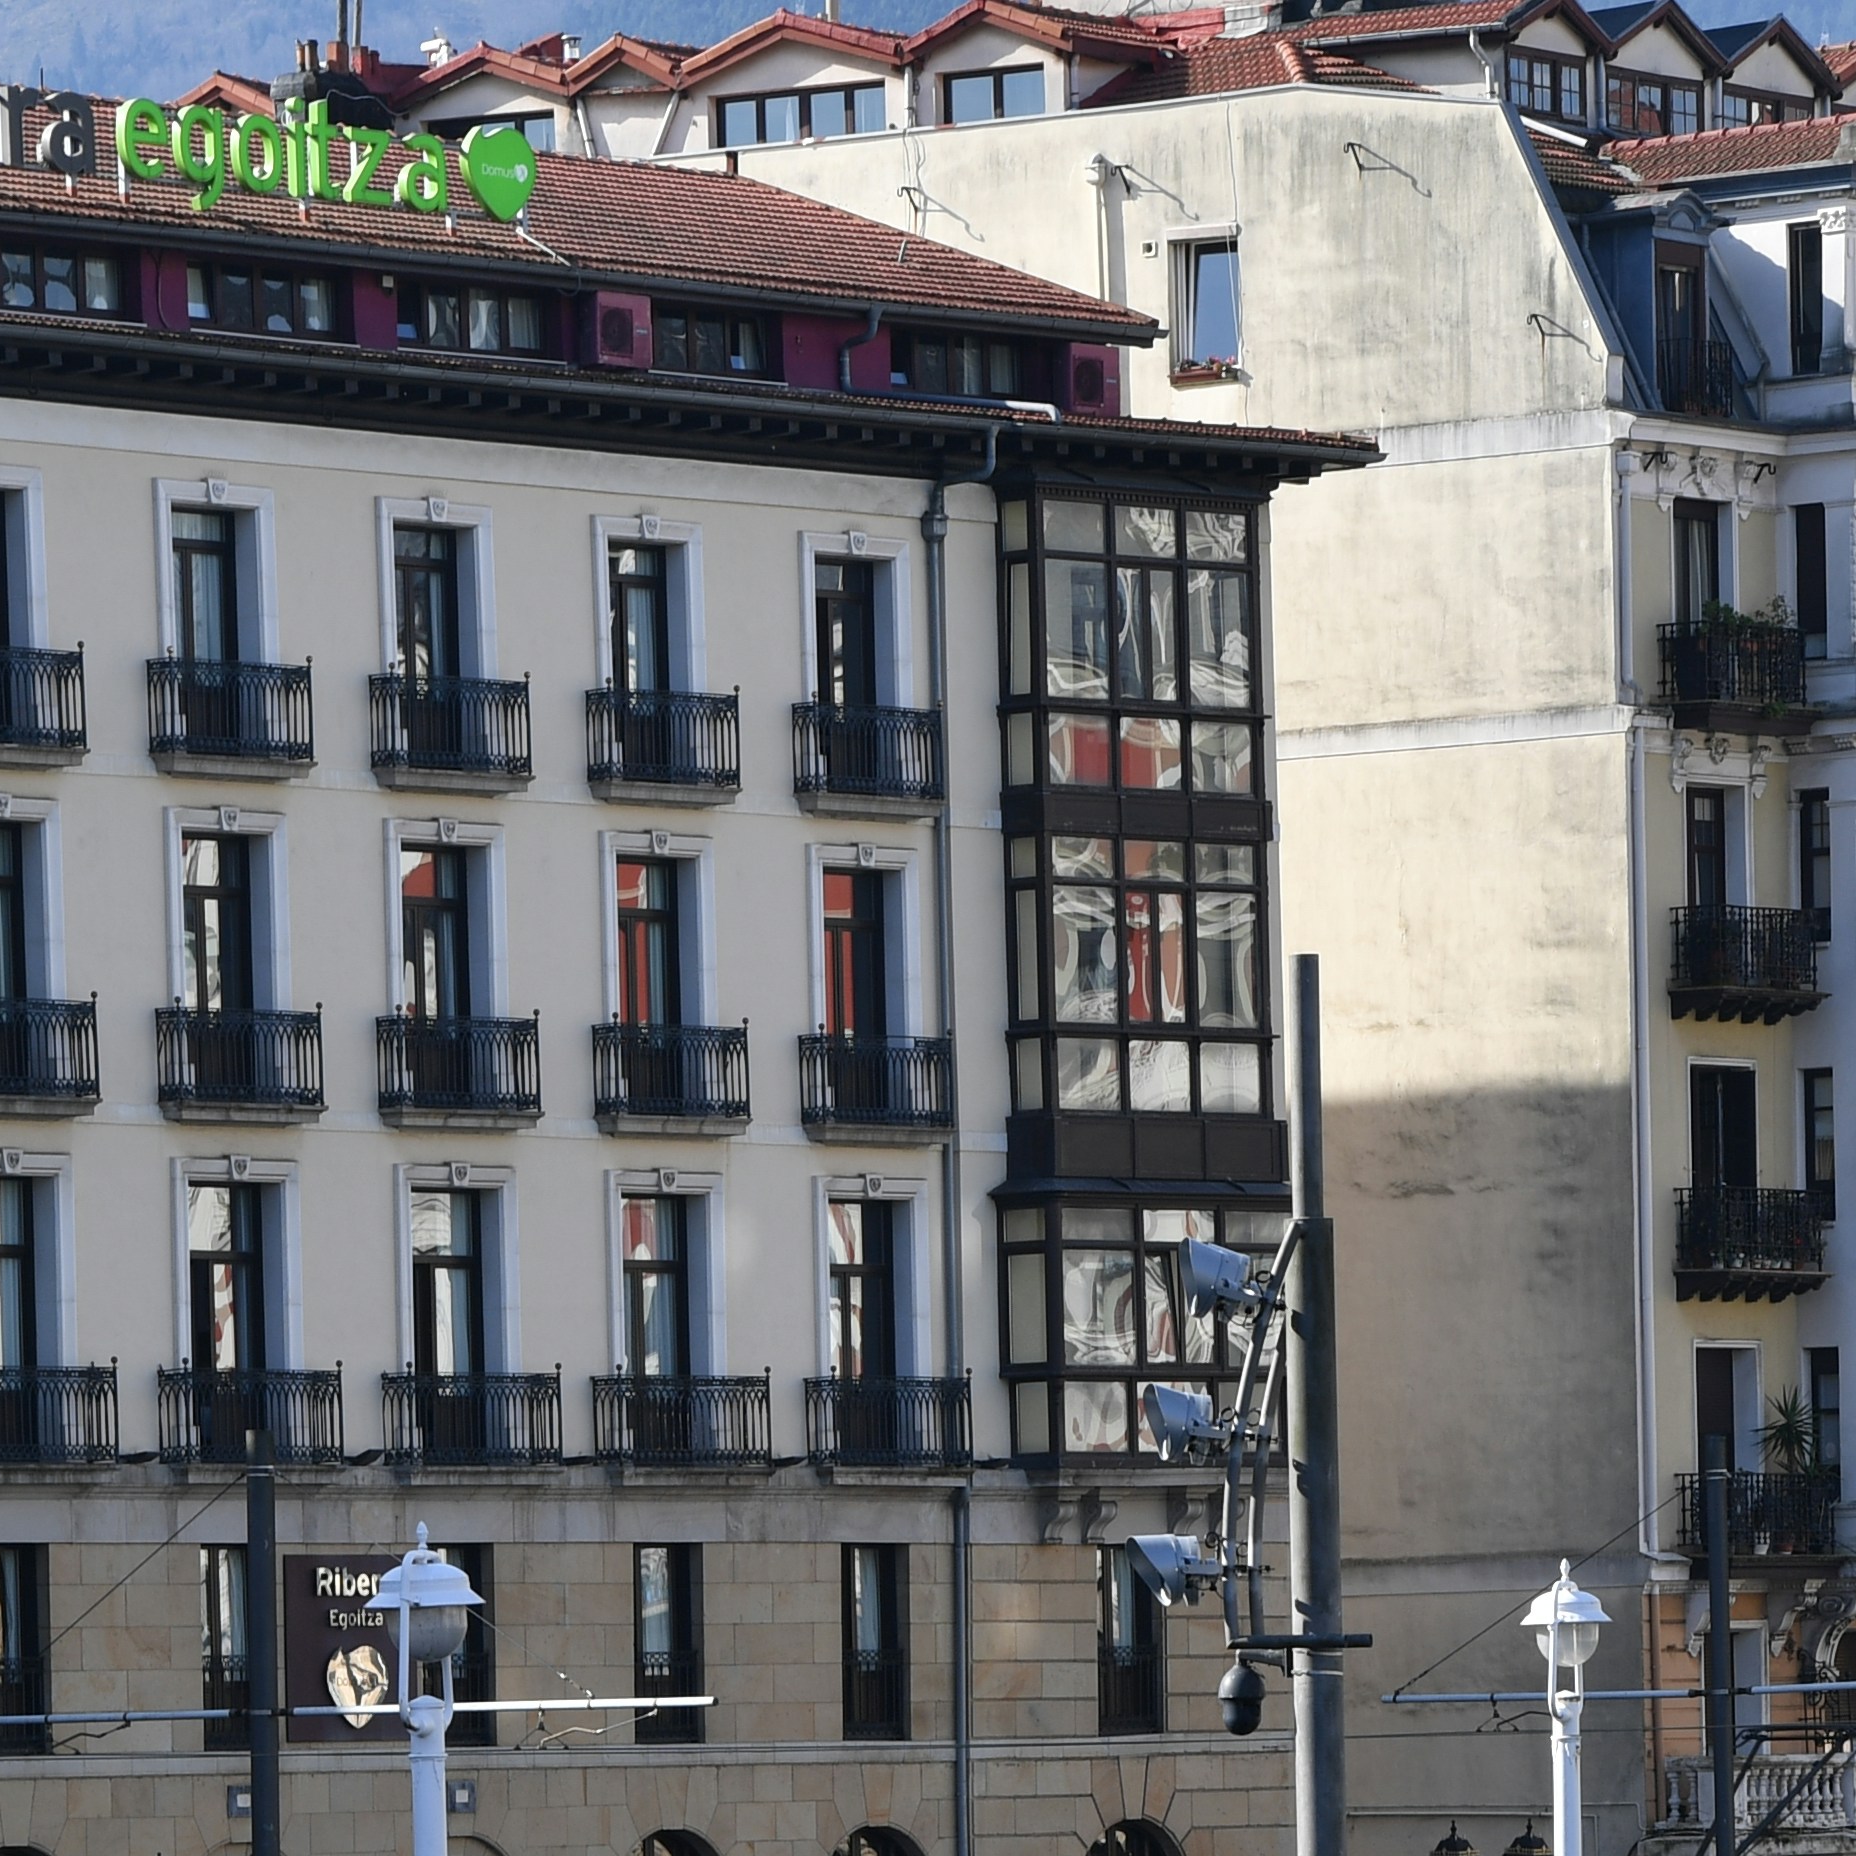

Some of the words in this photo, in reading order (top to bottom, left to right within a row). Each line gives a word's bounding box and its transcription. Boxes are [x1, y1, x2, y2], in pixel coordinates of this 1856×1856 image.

[117, 97, 448, 212] egoitza
[315, 1566, 381, 1597] Riber
[329, 1608, 384, 1631] Egoitza
